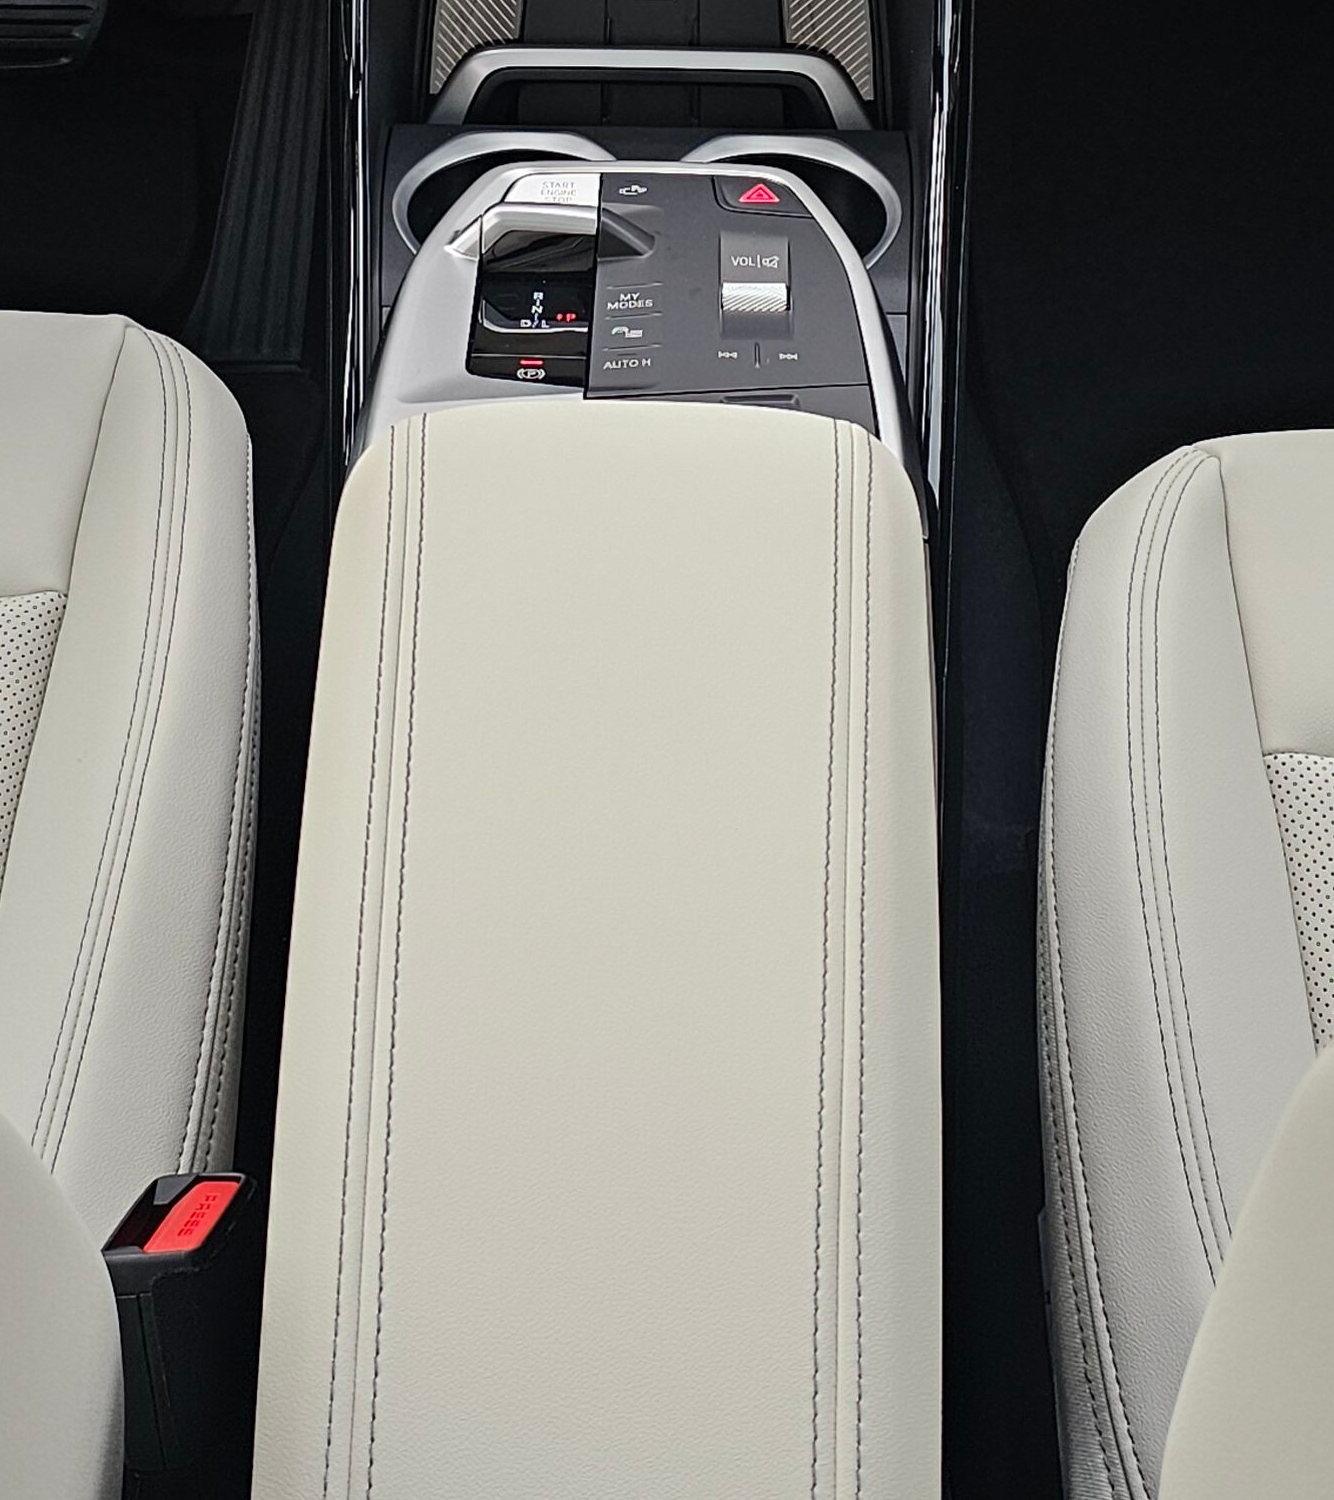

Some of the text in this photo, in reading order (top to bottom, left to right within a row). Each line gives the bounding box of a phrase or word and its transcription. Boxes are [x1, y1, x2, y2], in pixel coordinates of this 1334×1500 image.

[542, 181, 575, 189] START
[540, 189, 577, 197] ENGINE
[731, 256, 755, 267] VOL
[619, 292, 640, 301] MY
[607, 300, 653, 310] MODES
[531, 306, 543, 314] N
[603, 358, 651, 370] AUTO H
[177, 1195, 218, 1236] PRESS
